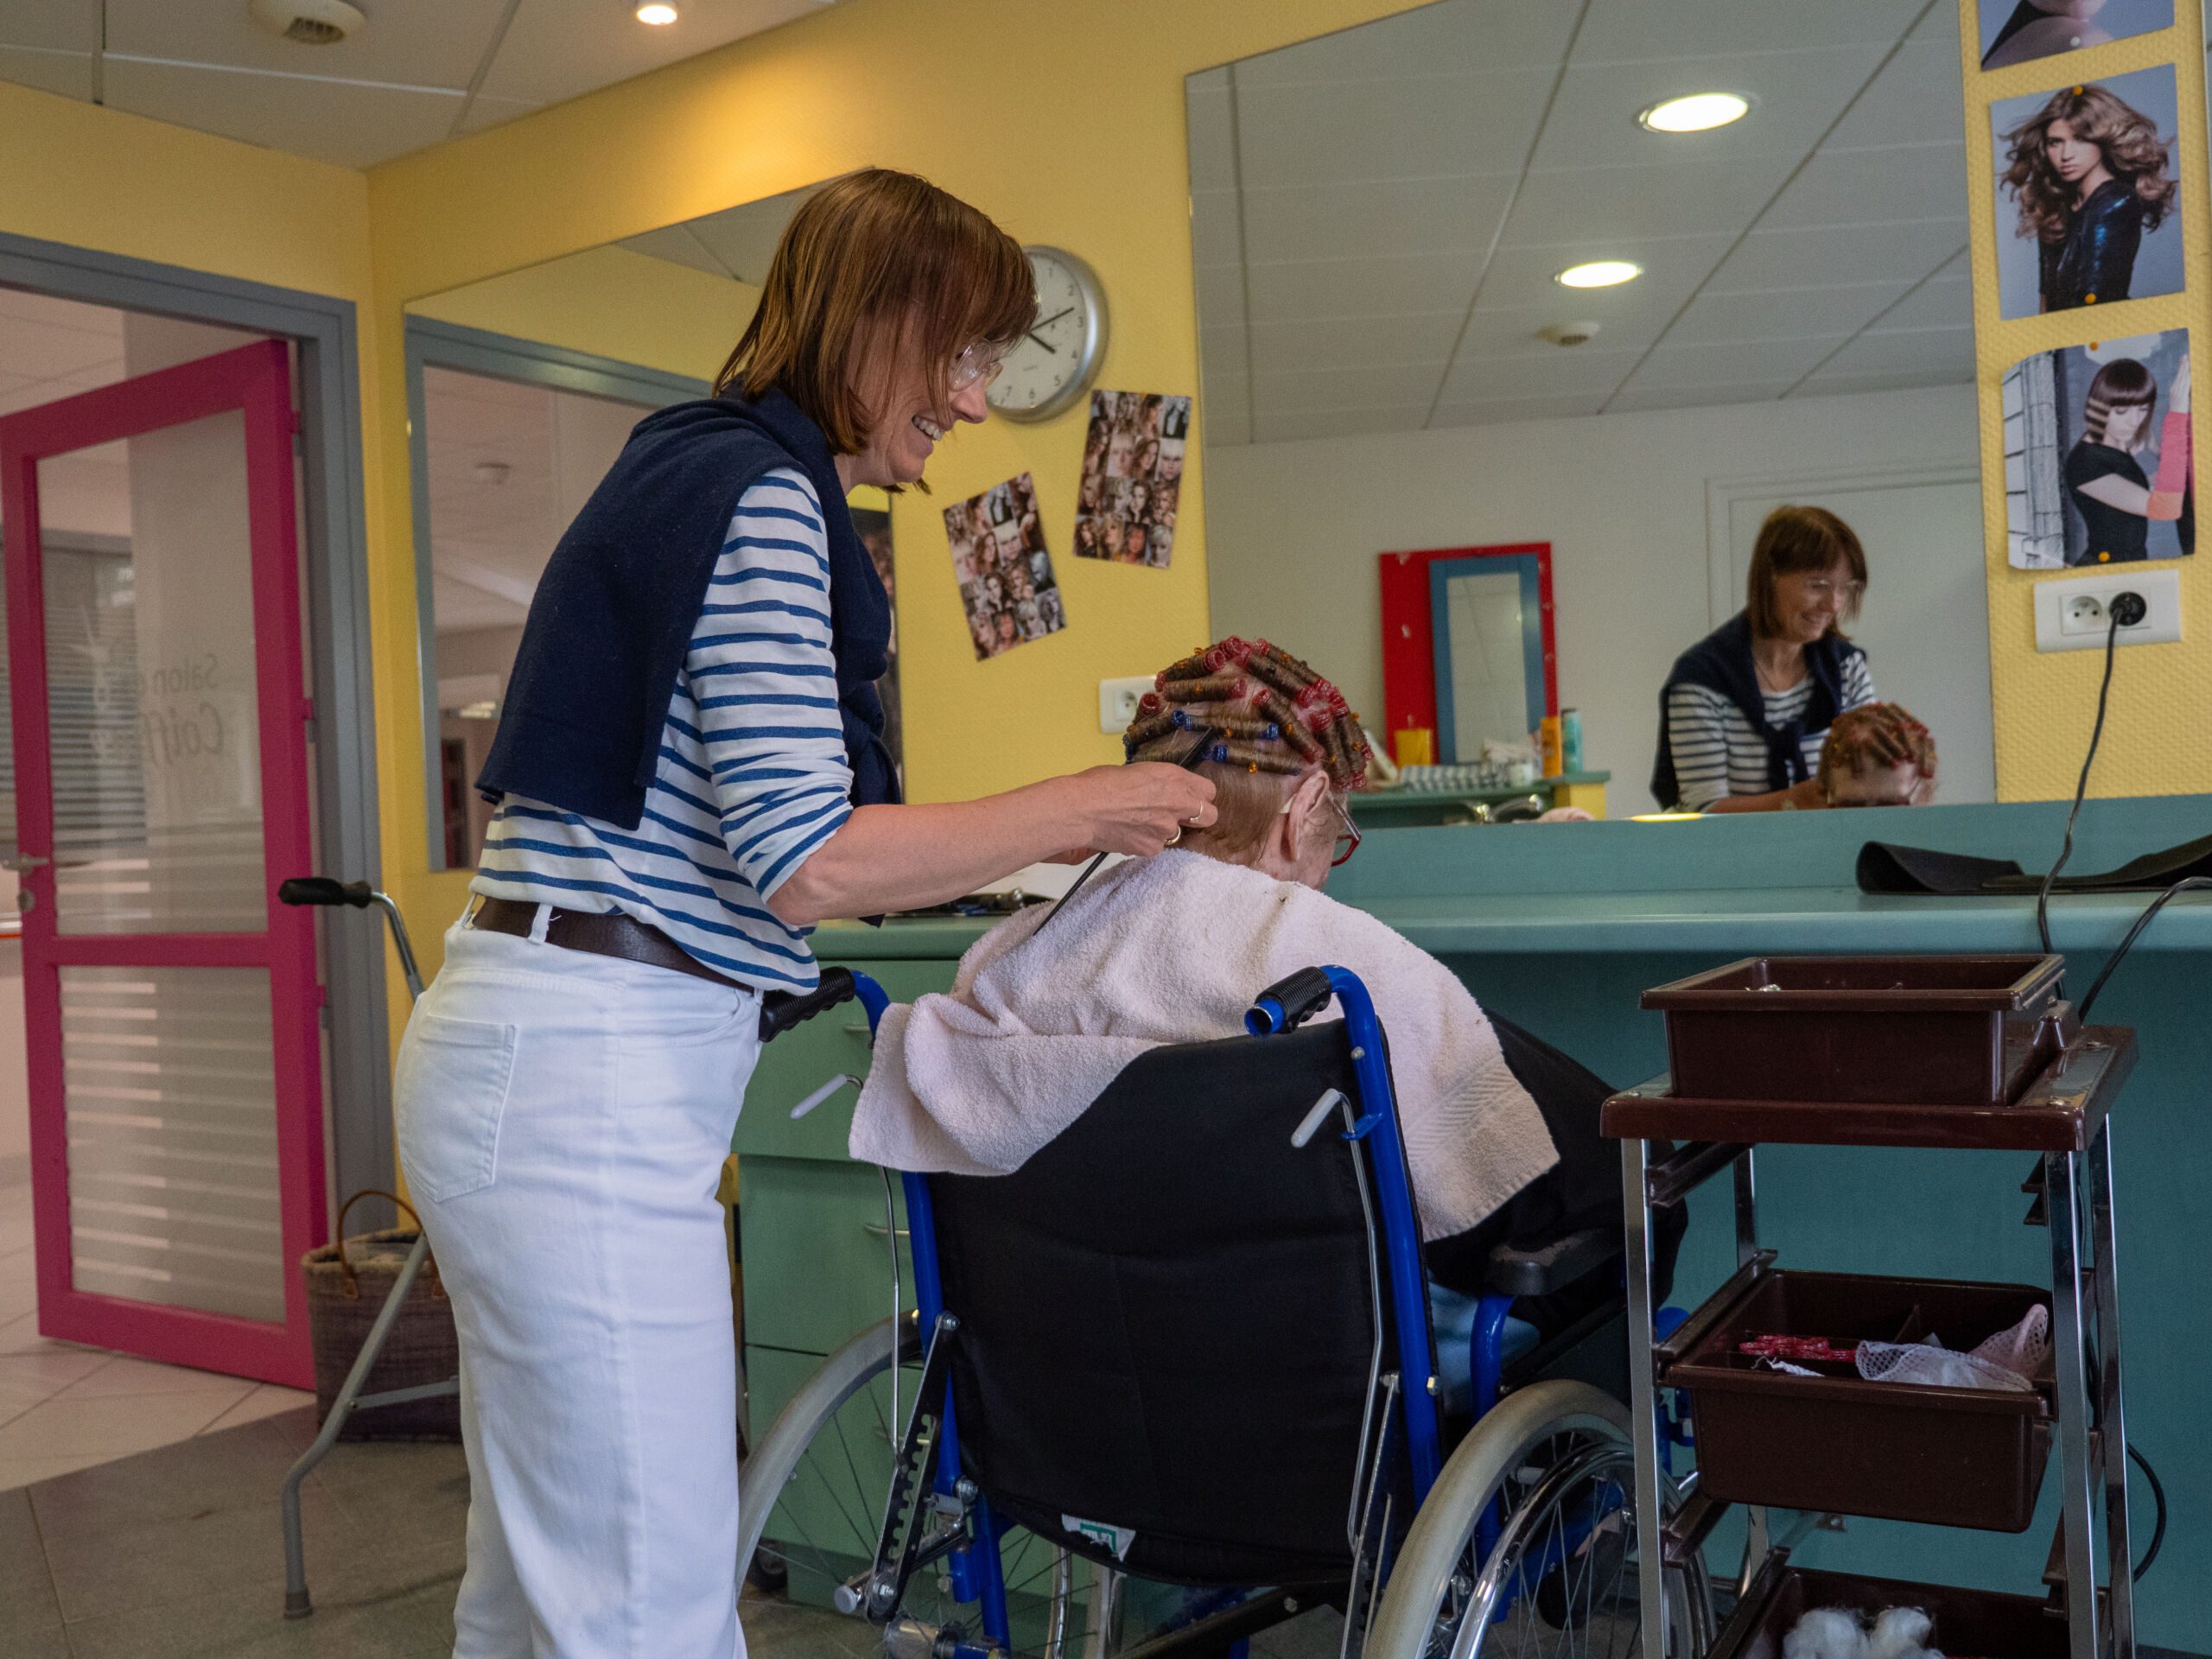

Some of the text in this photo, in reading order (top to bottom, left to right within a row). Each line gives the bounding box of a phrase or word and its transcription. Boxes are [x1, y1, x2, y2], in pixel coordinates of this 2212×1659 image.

[1066, 284, 1074, 296] 2
[1077, 316, 1084, 328] 3
[1071, 349, 1078, 359] 4
[1053, 375, 1061, 386] 5
[1006, 385, 1013, 397] 7
[1028, 389, 1036, 400] 6
